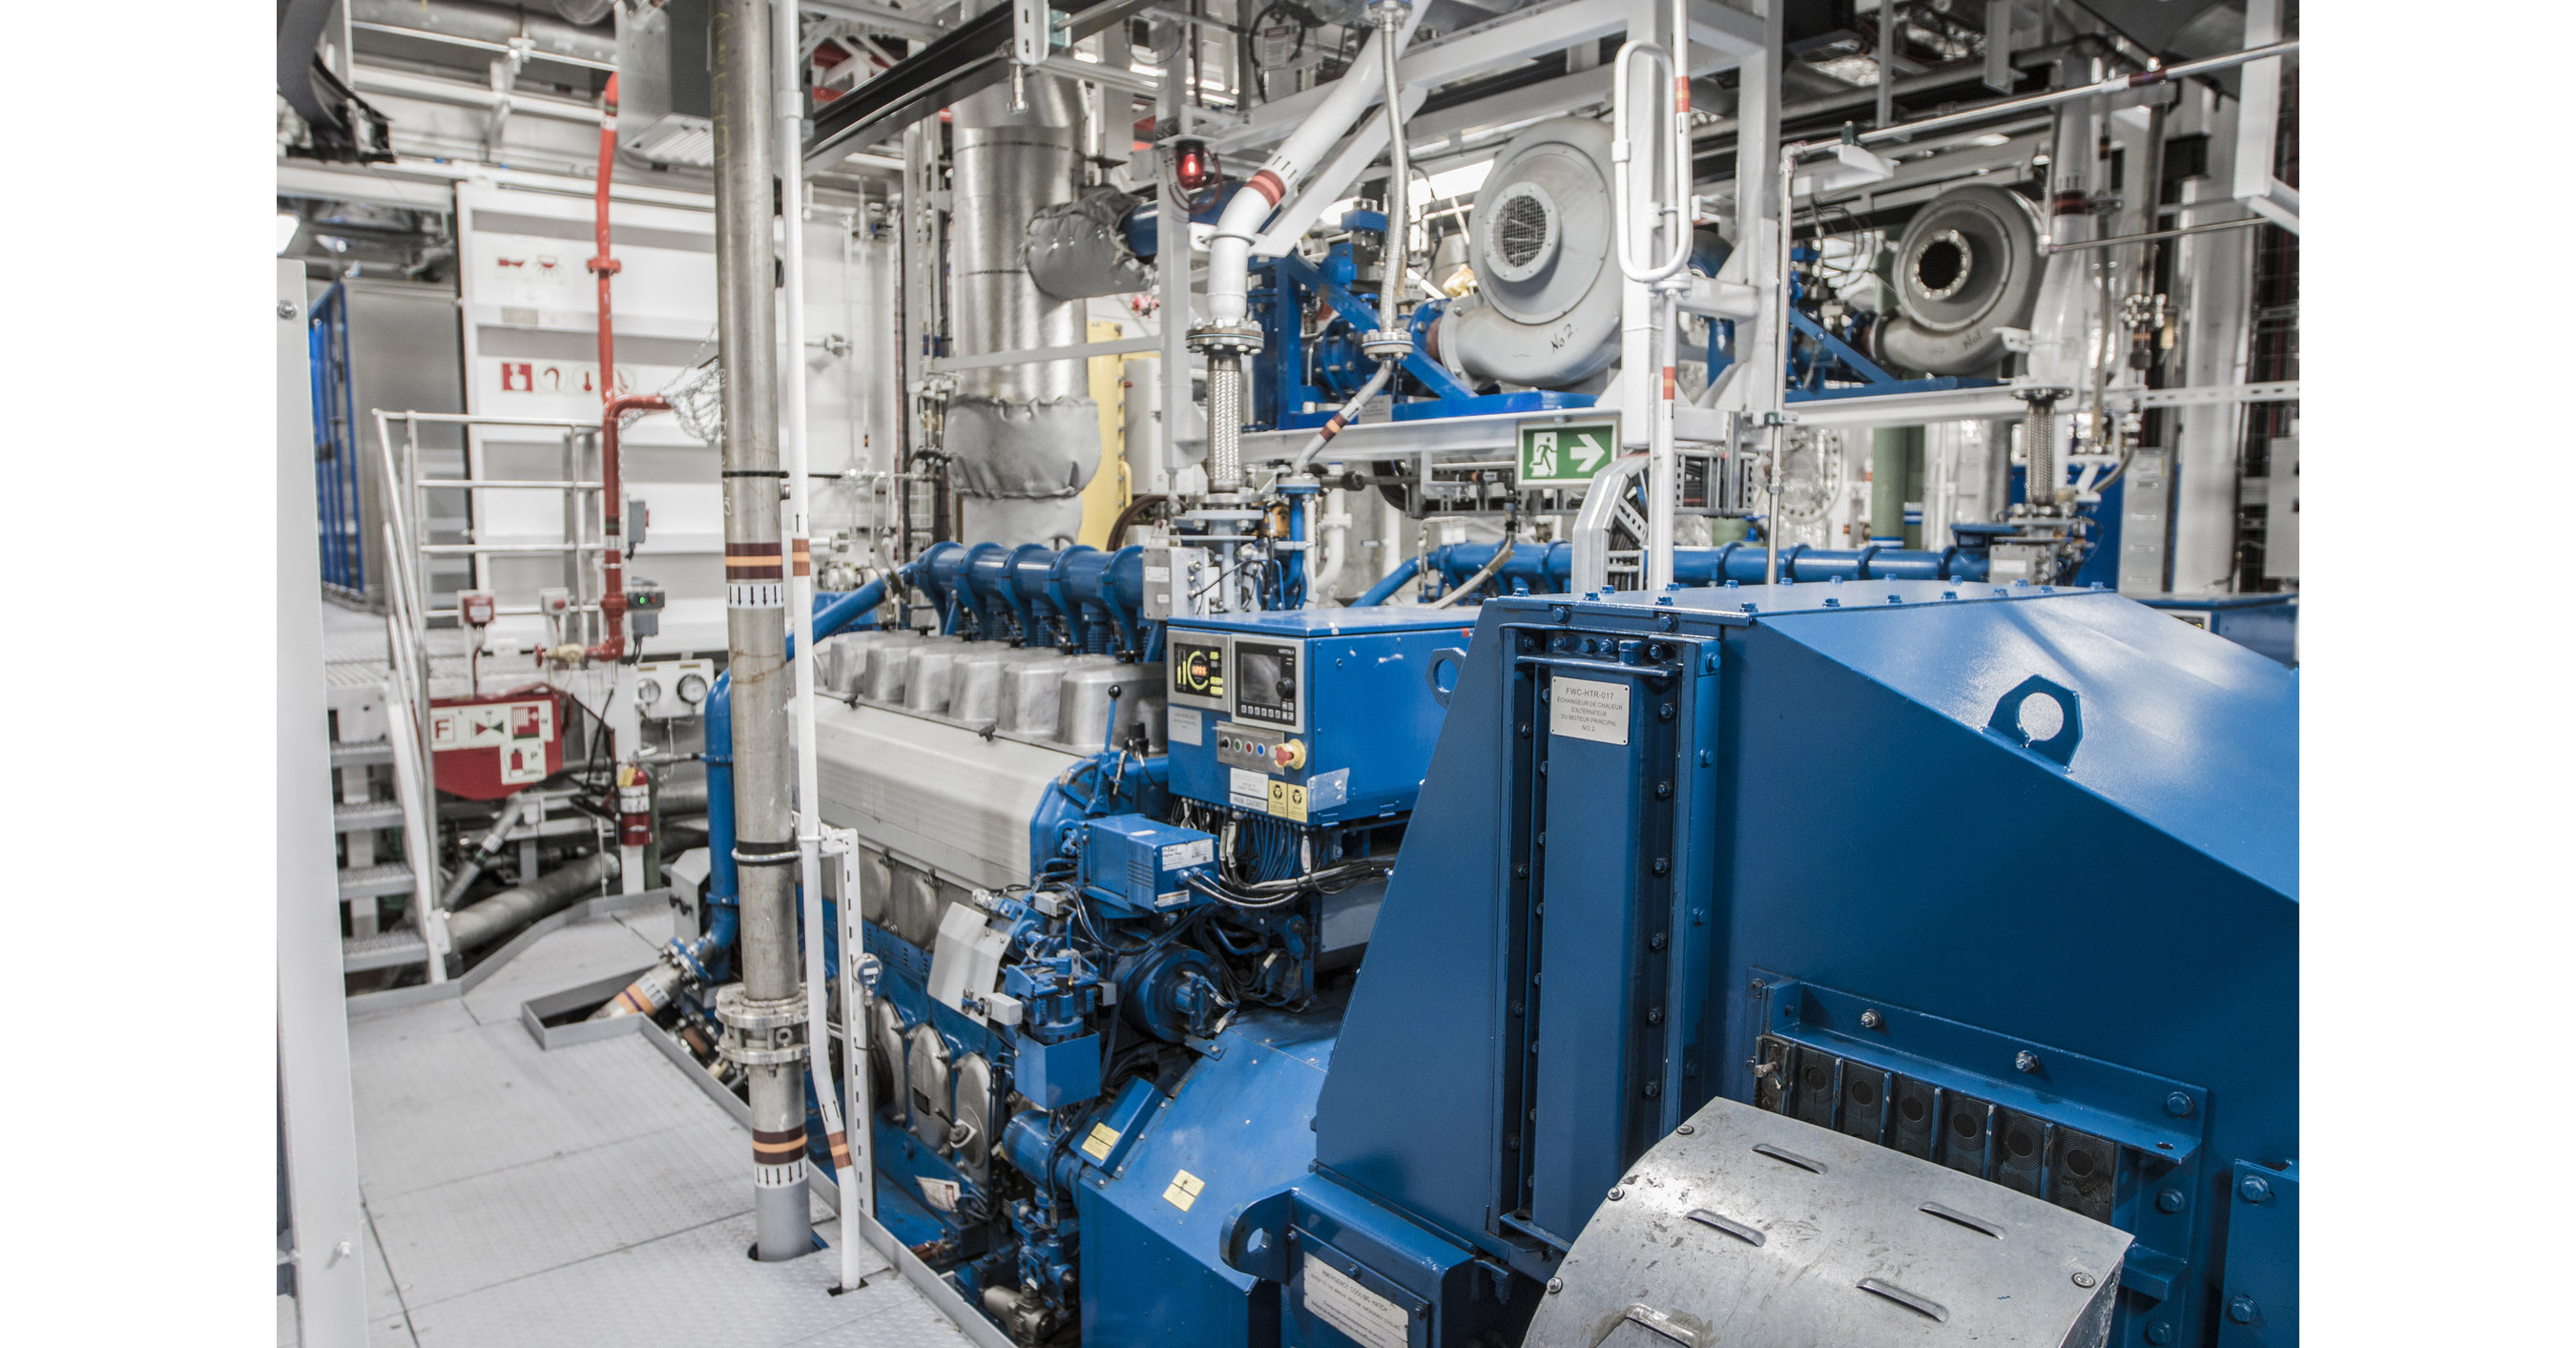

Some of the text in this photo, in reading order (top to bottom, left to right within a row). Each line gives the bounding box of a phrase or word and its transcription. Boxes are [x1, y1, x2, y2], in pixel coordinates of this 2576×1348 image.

[1566, 687, 1614, 700] FWC-HTR-017
[1570, 706, 1608, 716] D'ALTERNATEUR
[1597, 701, 1623, 711] CHALEUR
[1568, 714, 1590, 723] MOTEUR
[1589, 717, 1617, 727] PRINCIPAL
[435, 718, 449, 738] F
